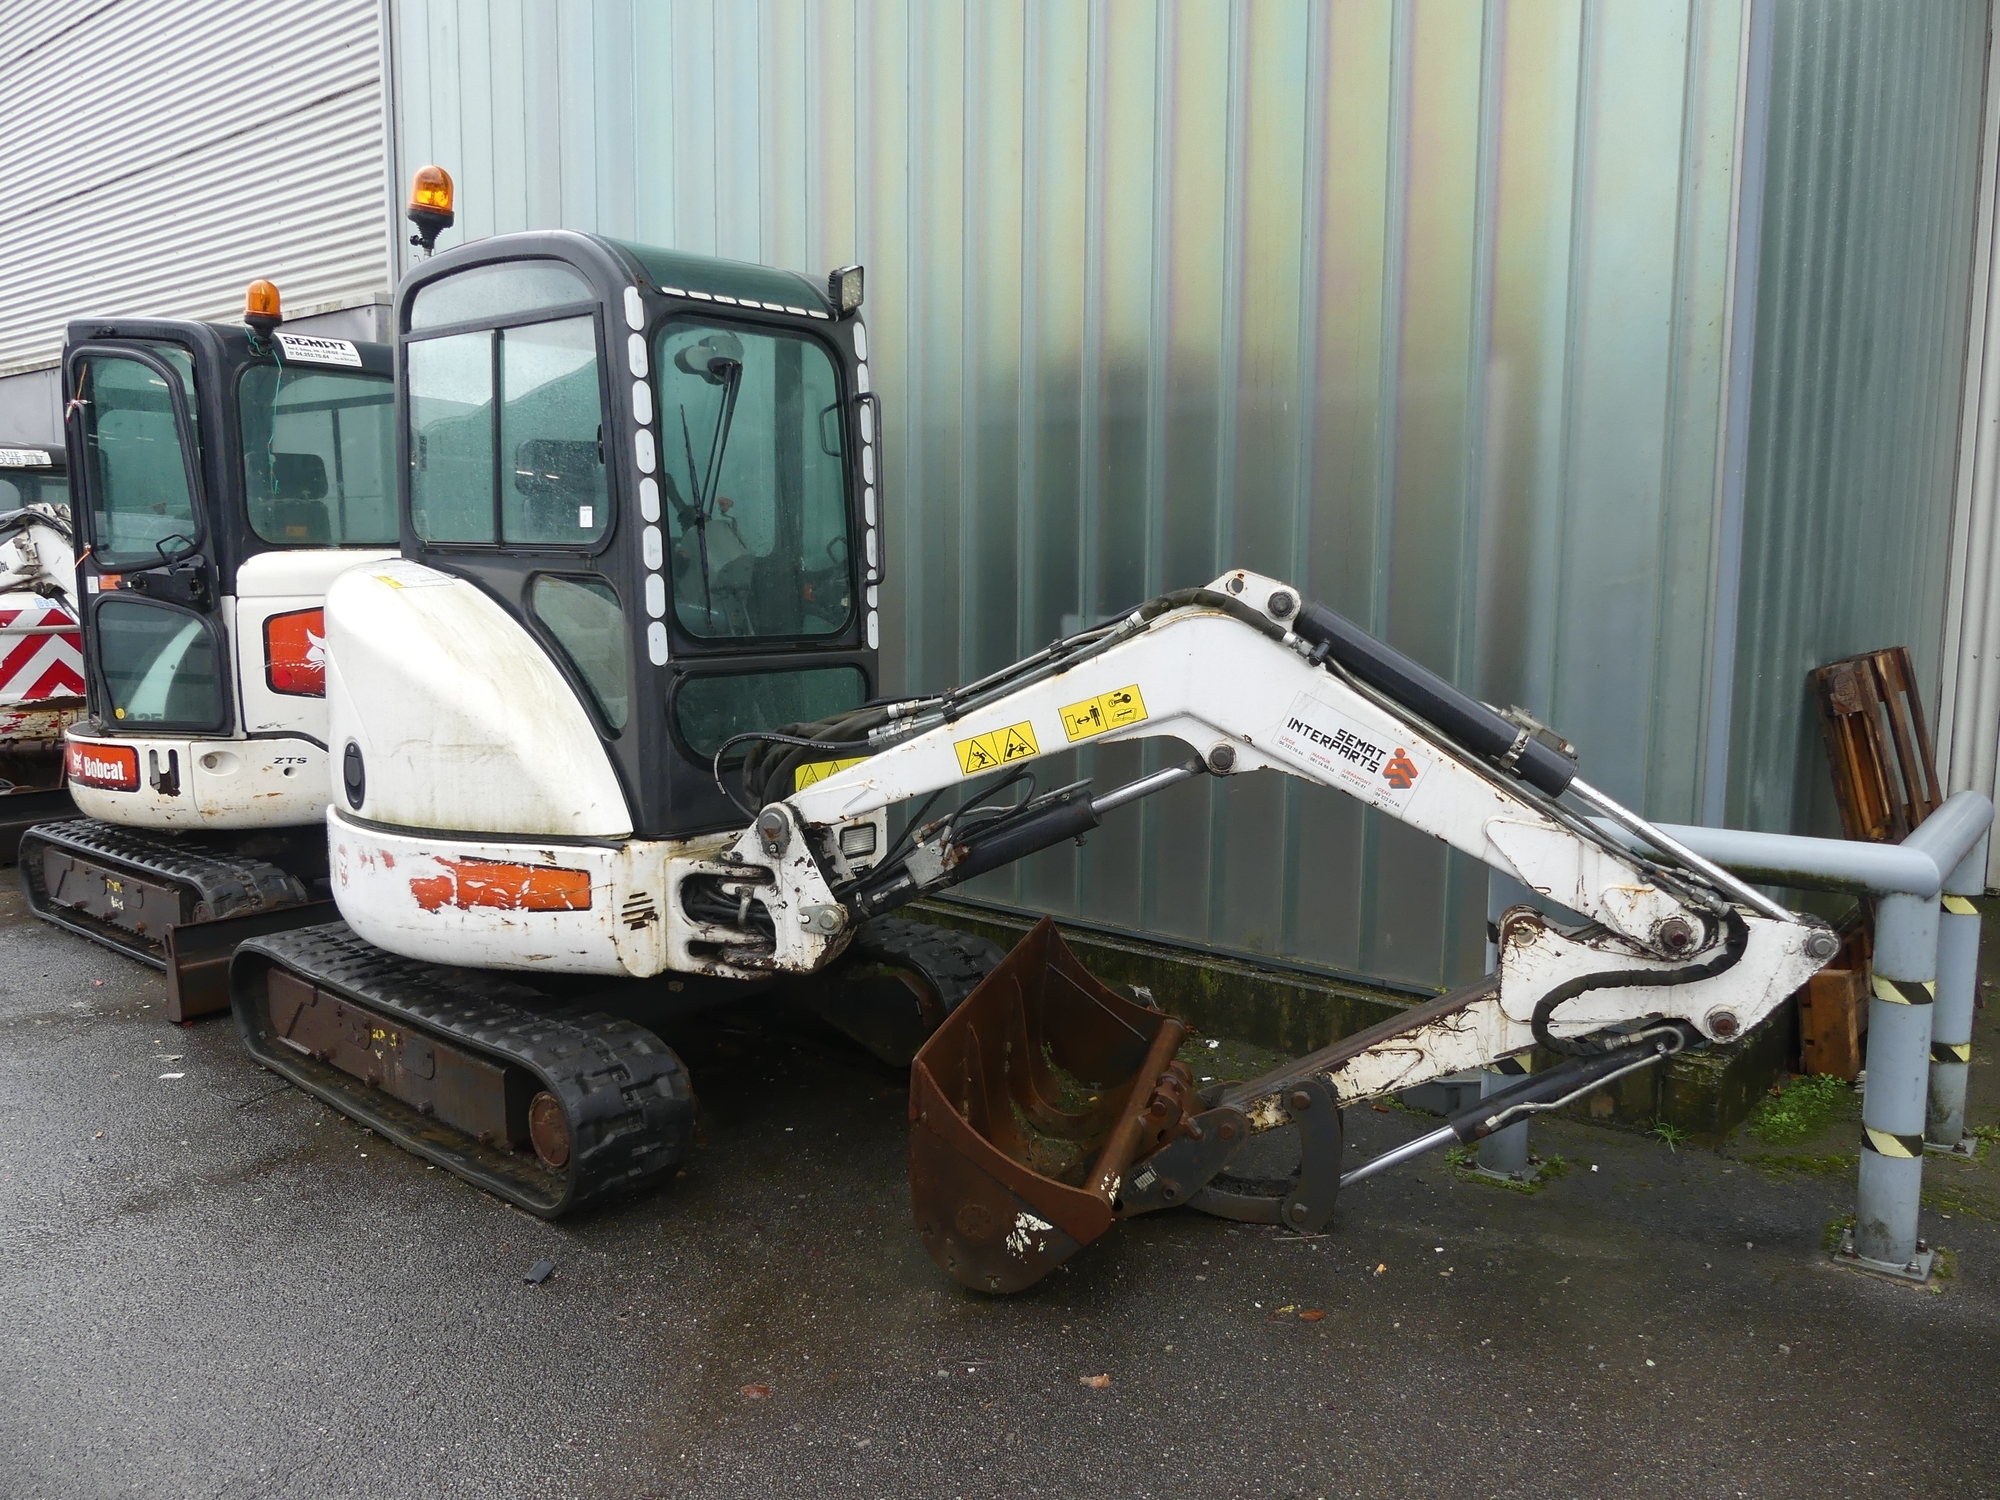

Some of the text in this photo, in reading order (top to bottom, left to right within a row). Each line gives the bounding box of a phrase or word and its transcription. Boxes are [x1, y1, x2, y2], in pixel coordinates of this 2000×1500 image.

[283, 336, 346, 350] SEMAT
[1287, 717, 1381, 774] INTERPARTS
[1334, 728, 1386, 761] SEMAT
[1312, 752, 1331, 764] NAMUR
[83, 756, 124, 781] Bobcat
[1343, 769, 1372, 786] LIBRAMONT
[1377, 787, 1392, 797] GENT
